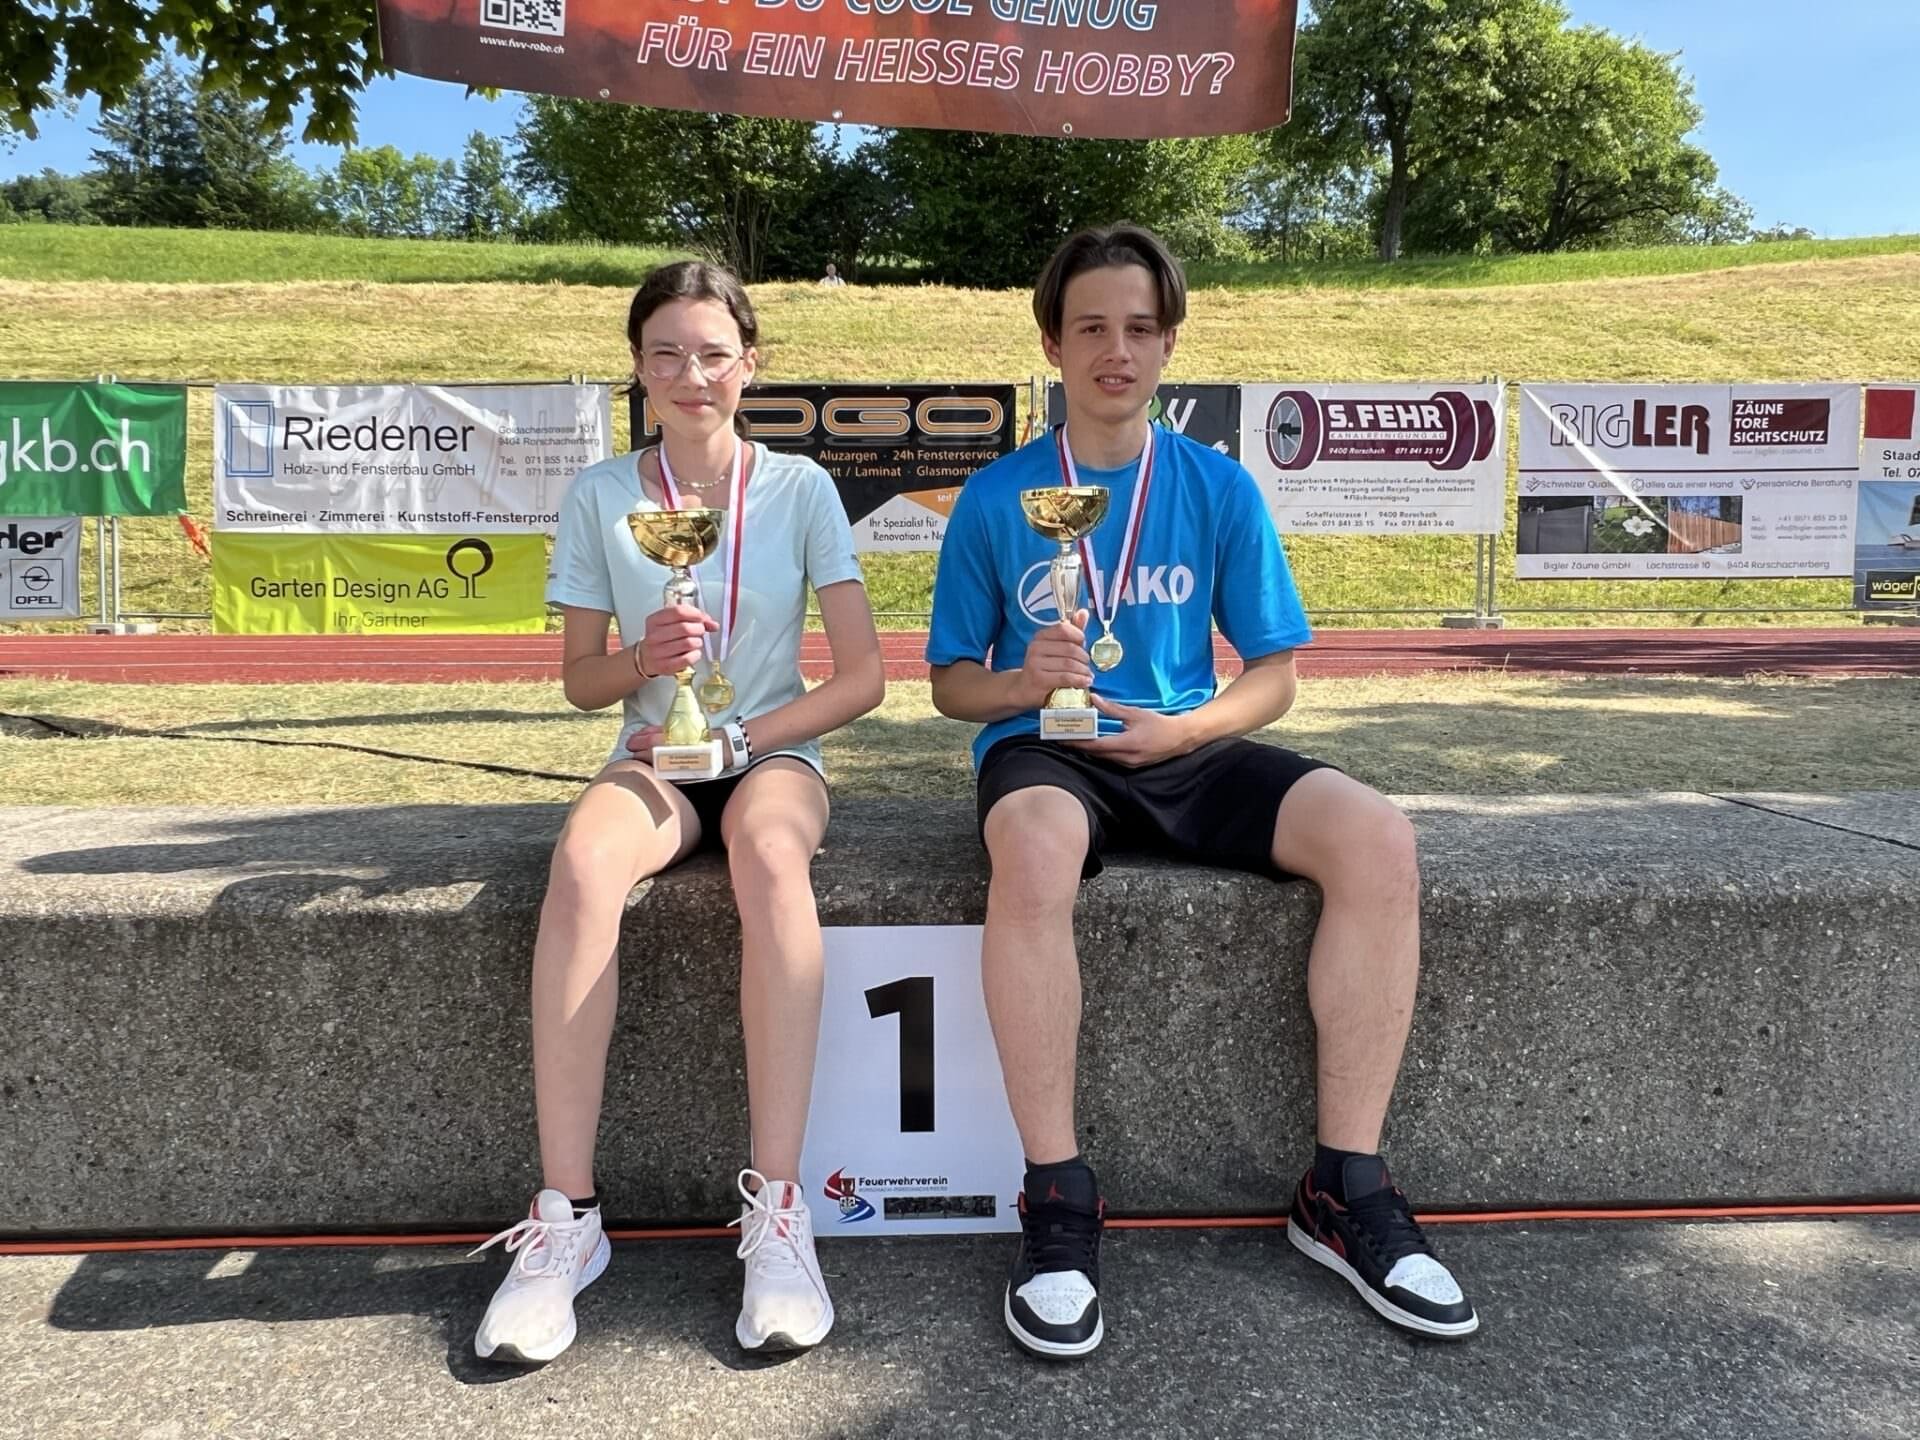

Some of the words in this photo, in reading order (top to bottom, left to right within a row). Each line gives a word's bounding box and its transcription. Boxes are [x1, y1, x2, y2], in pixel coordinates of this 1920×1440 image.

[637, 15, 732, 71] FÜR
[743, 32, 826, 78] EIN
[834, 38, 1023, 90] HEISSES
[1034, 50, 1235, 96] HOBBY?
[1735, 401, 1784, 415] ZÄUNE
[1327, 404, 1444, 428] S.FEHR
[579, 424, 595, 433] 101
[1550, 399, 1710, 454] BIGLER
[1734, 418, 1769, 429] TORE
[282, 416, 475, 452] Riedener
[1733, 430, 1825, 443] SICHTSCHUTZ
[0, 417, 150, 486] kb.ch
[819, 450, 878, 463] Aluzargen
[892, 450, 914, 461] 24h
[917, 450, 999, 461] Fensterservice
[525, 456, 542, 464] 071
[564, 456, 575, 464] 14
[577, 456, 588, 464] 42
[283, 463, 319, 476] Holz-
[323, 463, 348, 476] und
[352, 463, 430, 476] Fensterbau
[433, 463, 475, 476] GmbH
[855, 467, 901, 477] Laminat
[916, 466, 985, 476] Glasmonta
[1883, 467, 1902, 477] Tel.
[1542, 480, 1586, 488] Schweizer
[1709, 480, 1733, 488] Hand
[1811, 479, 1852, 489] Beratung
[226, 510, 307, 523] Schreinerei
[319, 510, 385, 523] Zimmerei
[397, 510, 559, 525] Kunststoff-Fensterprod
[869, 517, 880, 527] Ihr
[884, 517, 924, 530] Spezialist
[926, 516, 938, 527] für
[873, 531, 921, 540] Renovation
[1543, 562, 1568, 572] Bigler
[1571, 561, 1600, 569] Zäune
[1602, 561, 1631, 569] GmbH
[1702, 561, 1711, 569] 10
[1727, 561, 1749, 569] 9404
[1751, 560, 1830, 570] Rorschacherberg
[251, 577, 326, 598] Garten
[333, 578, 410, 603] Design
[416, 578, 449, 598] AG
[1872, 579, 1914, 593] wäger
[16, 596, 58, 604] OPEL
[333, 612, 356, 628] Ihr
[361, 611, 428, 628] Gärtner
[864, 976, 935, 1132] 1
[859, 1176, 948, 1186] Feuerwehrverein
